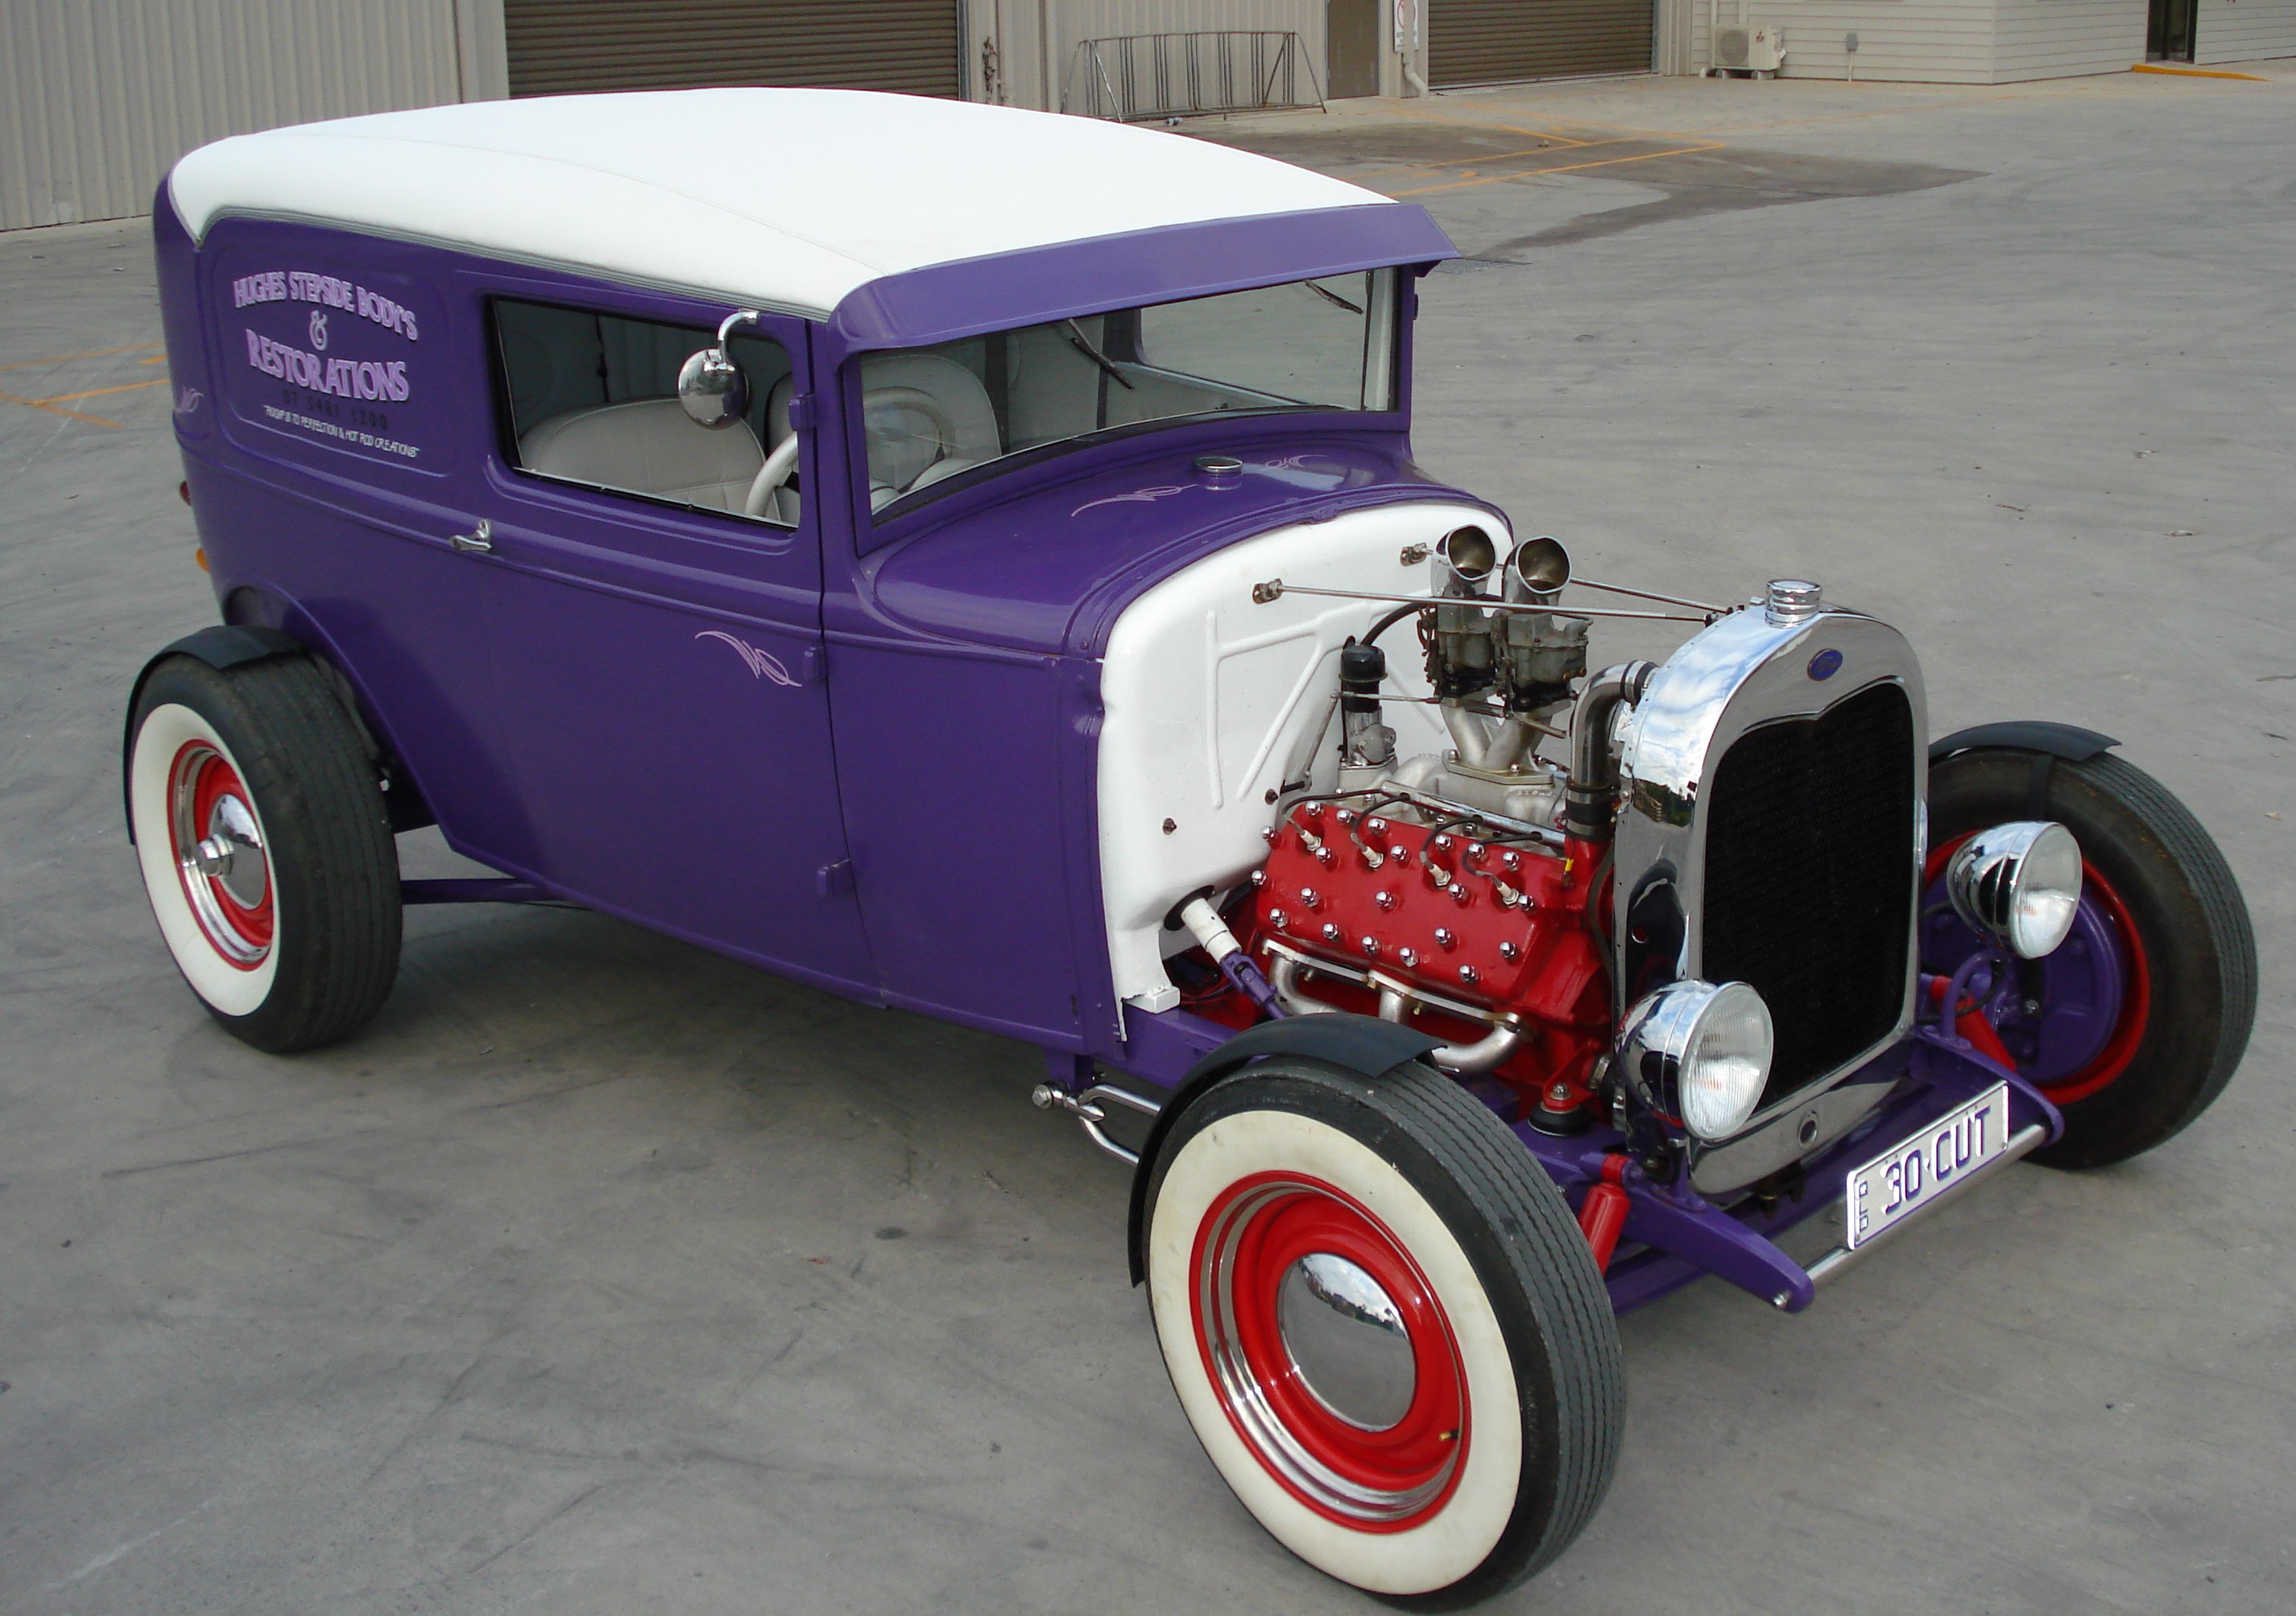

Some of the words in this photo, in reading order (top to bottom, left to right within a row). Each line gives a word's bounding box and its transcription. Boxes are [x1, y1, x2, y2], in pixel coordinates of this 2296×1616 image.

[233, 271, 287, 308] HUGHES
[288, 271, 355, 312] STEPSIDE
[356, 285, 418, 341] BODY'S
[309, 309, 329, 351] &
[246, 329, 410, 402] RESTORATIONS
[345, 429, 358, 442] HOT
[359, 433, 374, 447] ROD
